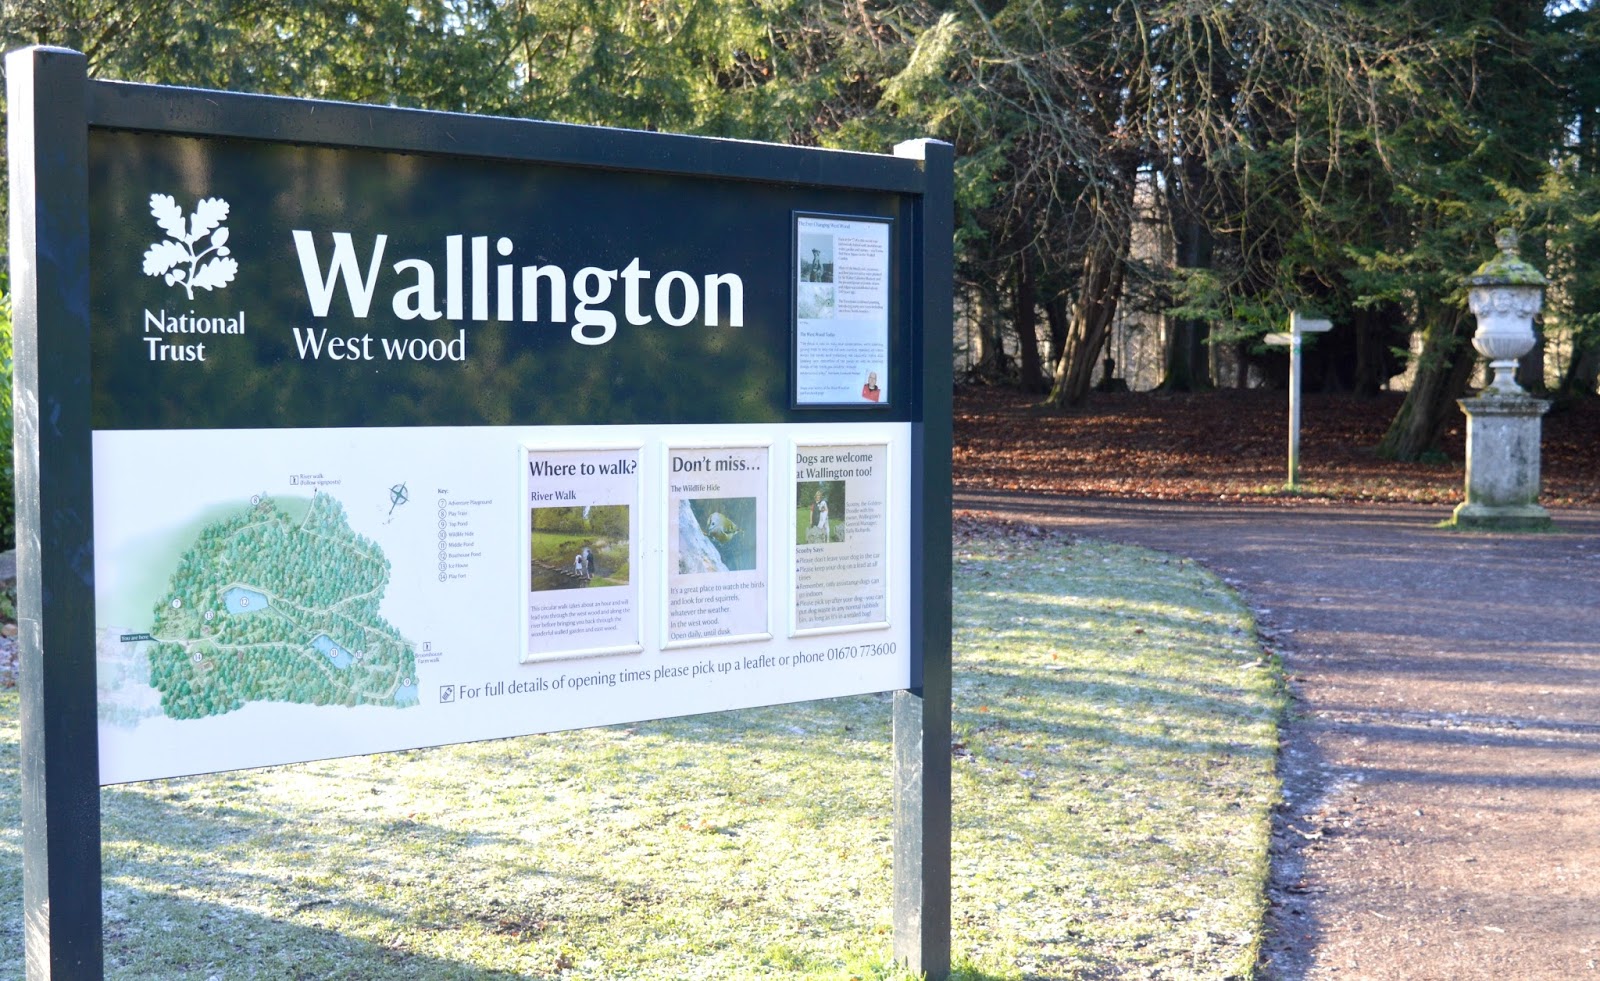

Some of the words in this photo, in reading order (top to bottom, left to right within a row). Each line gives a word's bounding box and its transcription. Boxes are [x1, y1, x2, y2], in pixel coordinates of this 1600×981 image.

[292, 230, 743, 345] Wallington
[144, 308, 245, 335] National
[143, 337, 206, 361] Trust
[292, 328, 373, 360] West
[382, 329, 465, 361] wood
[673, 456, 711, 472] Don’t
[797, 454, 818, 466] Dogs
[820, 455, 834, 463] are
[836, 452, 873, 462] welcome
[530, 461, 576, 476] Where
[580, 462, 595, 475] to
[599, 460, 637, 475] walk?
[806, 468, 853, 480] Wallington
[856, 467, 872, 476] too!
[531, 491, 553, 500] River
[555, 491, 576, 500] Walk
[684, 586, 698, 594] great
[700, 585, 714, 593] place
[682, 597, 694, 605] look
[460, 685, 481, 699] For
[485, 681, 504, 696] full
[508, 678, 548, 694] details
[552, 675, 566, 689] of
[568, 672, 616, 690] opening
[620, 669, 650, 683] times
[654, 663, 689, 681] please
[692, 660, 715, 677] pick
[718, 662, 732, 675] up
[735, 661, 740, 671] a
[743, 655, 775, 670] leaflet
[779, 657, 790, 666] or
[793, 652, 825, 667] phone
[828, 647, 858, 661] 01670
[860, 642, 897, 658] 773600
